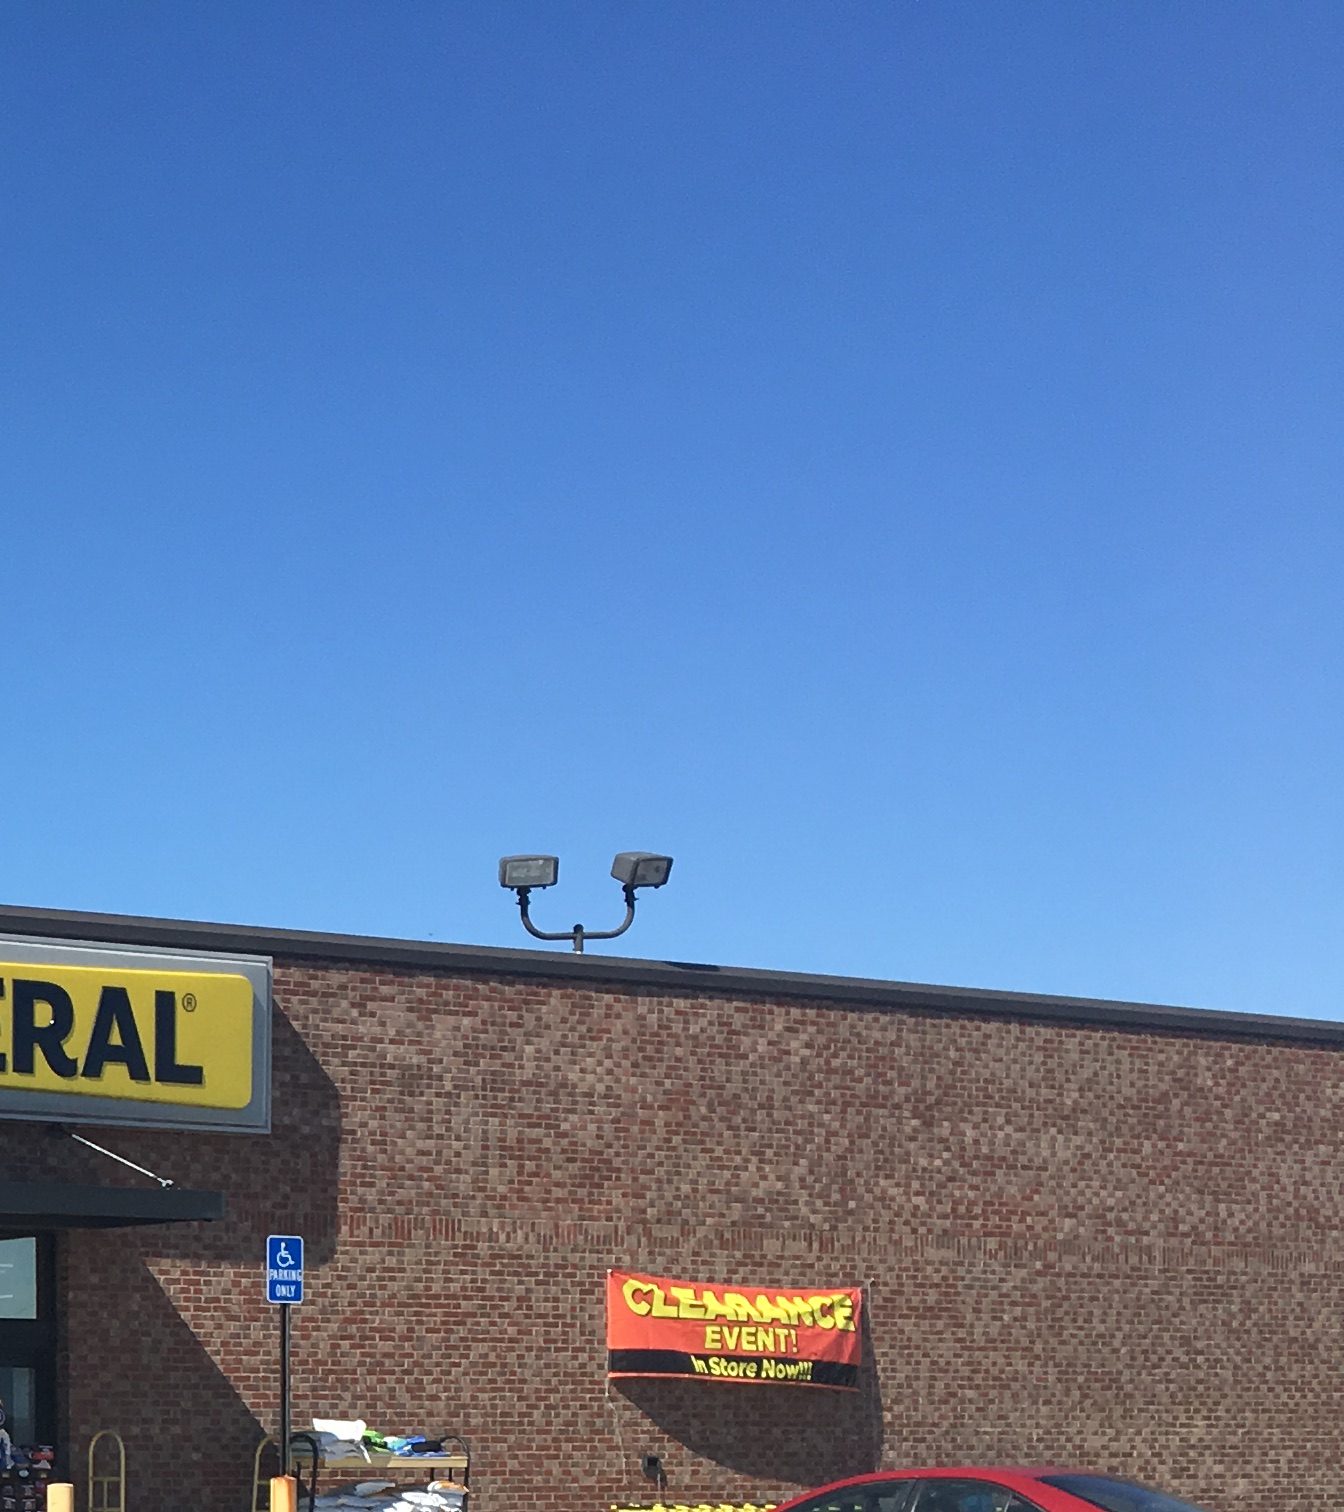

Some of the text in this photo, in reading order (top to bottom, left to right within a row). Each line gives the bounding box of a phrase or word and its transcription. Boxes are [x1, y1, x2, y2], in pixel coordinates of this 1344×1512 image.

[269, 1268, 302, 1282] PARKING
[275, 1283, 296, 1298] ONLY
[621, 1278, 857, 1333] CLEARANCE
[704, 1325, 799, 1353] EVENT!
[690, 1355, 814, 1381] In Store Now!!!
